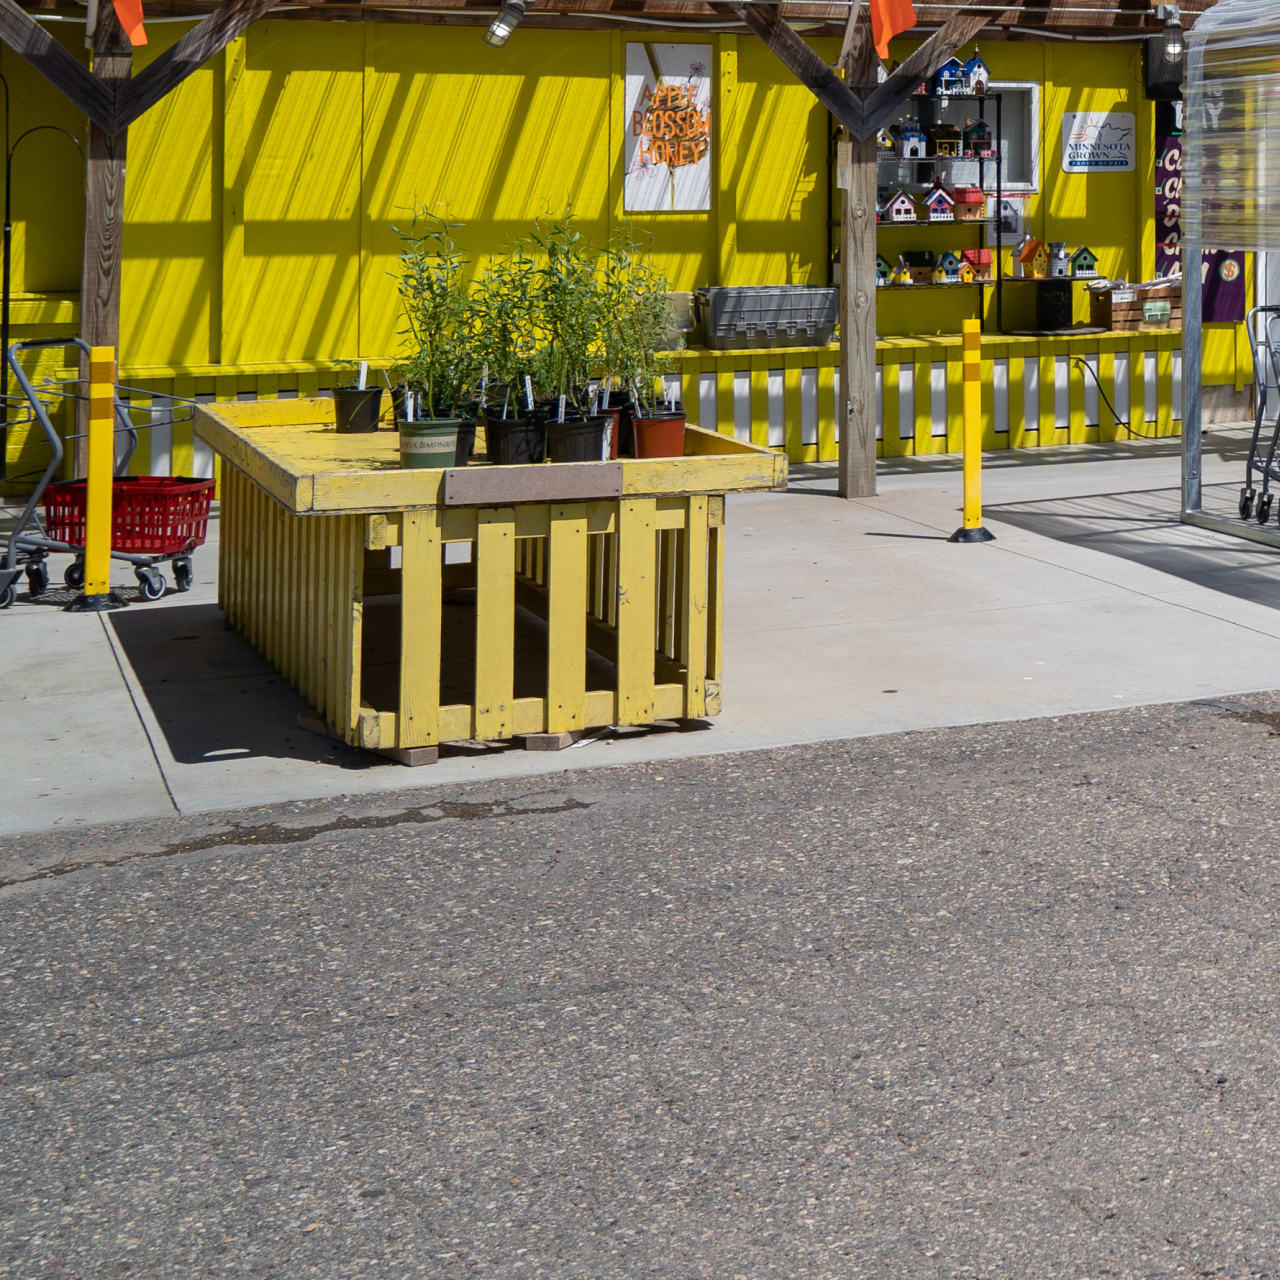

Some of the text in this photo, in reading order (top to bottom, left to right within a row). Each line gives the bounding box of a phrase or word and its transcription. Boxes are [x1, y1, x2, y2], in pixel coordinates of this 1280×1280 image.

[639, 83, 700, 107] APPLE
[632, 109, 712, 138] BLOSSOM
[639, 139, 705, 166] HONEY
[1068, 143, 1131, 151] MINNESOTA
[1068, 151, 1110, 159] GROWN
